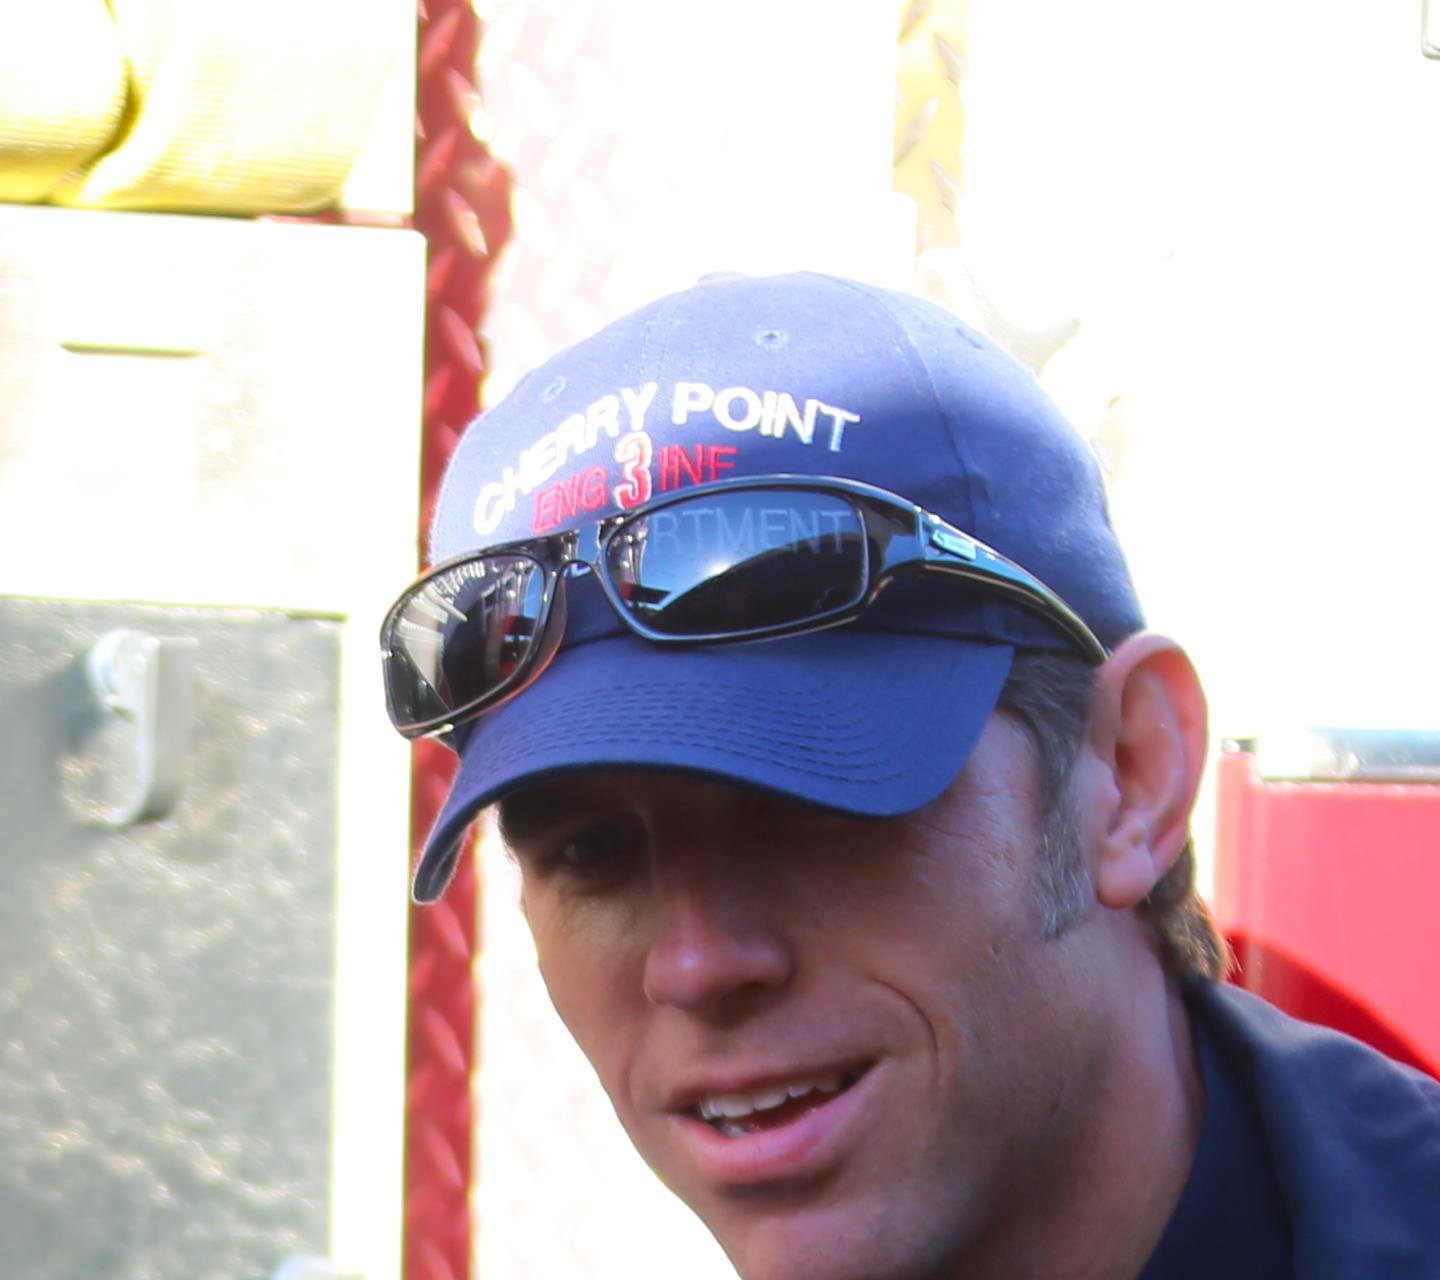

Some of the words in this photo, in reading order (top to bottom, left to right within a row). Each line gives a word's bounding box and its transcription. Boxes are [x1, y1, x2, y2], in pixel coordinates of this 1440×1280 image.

[473, 381, 658, 535] CHERRY
[672, 382, 861, 452] POINT
[652, 508, 852, 556] RTMENT
